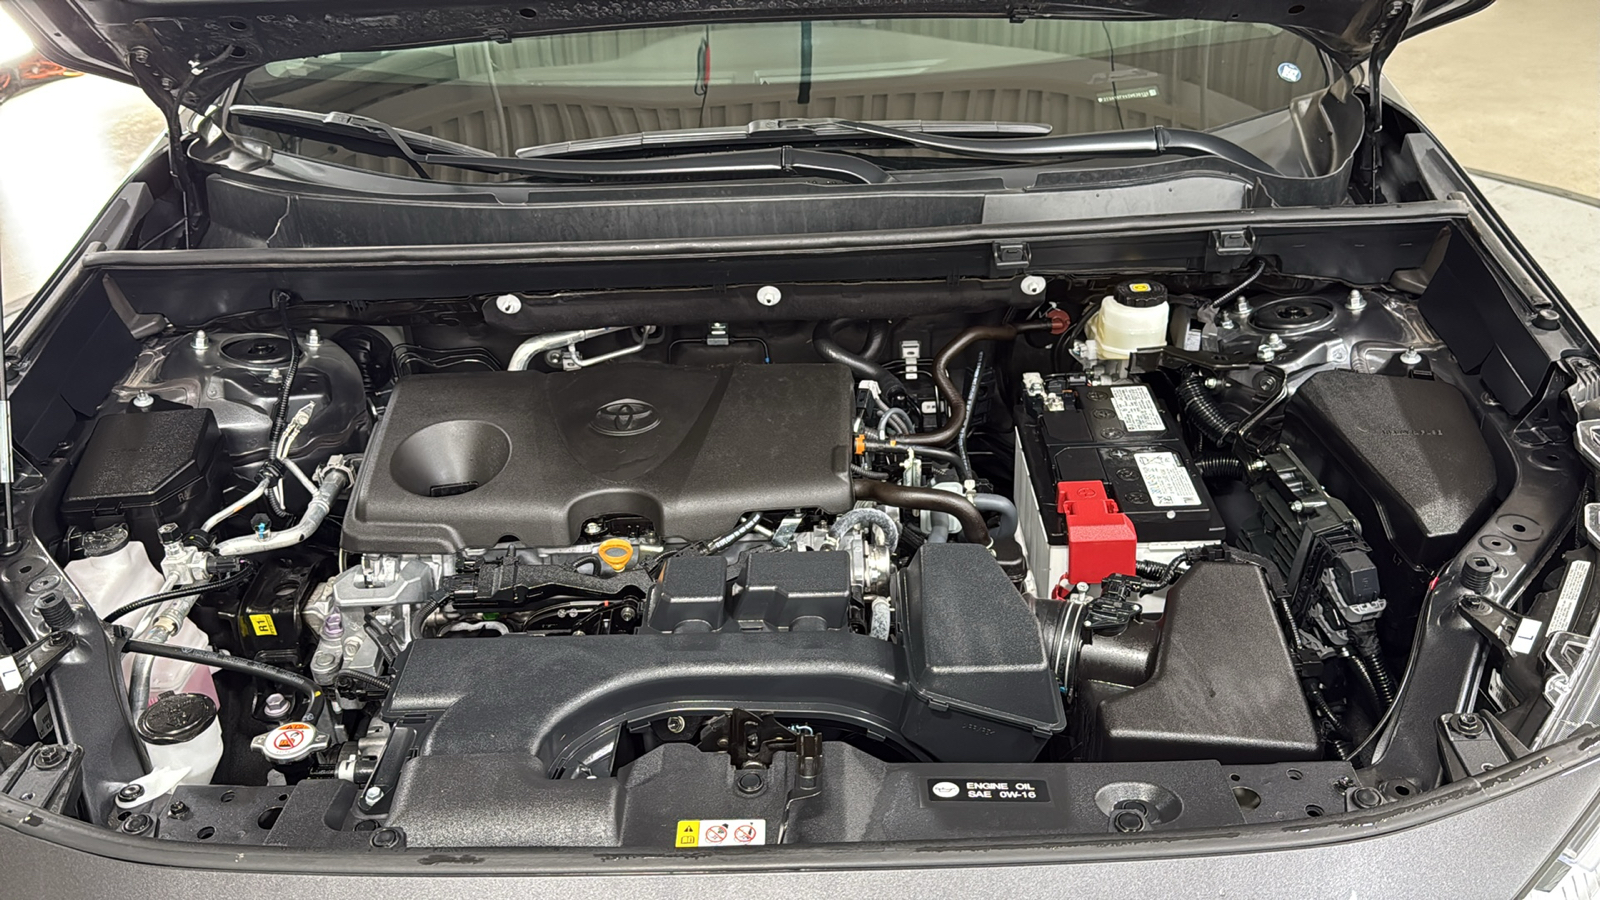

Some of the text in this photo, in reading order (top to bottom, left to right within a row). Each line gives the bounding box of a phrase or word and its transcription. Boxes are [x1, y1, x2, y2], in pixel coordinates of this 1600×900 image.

[257, 620, 268, 631] R1
[966, 782, 1009, 790] ENGINE
[999, 791, 1037, 799] 0W-16
